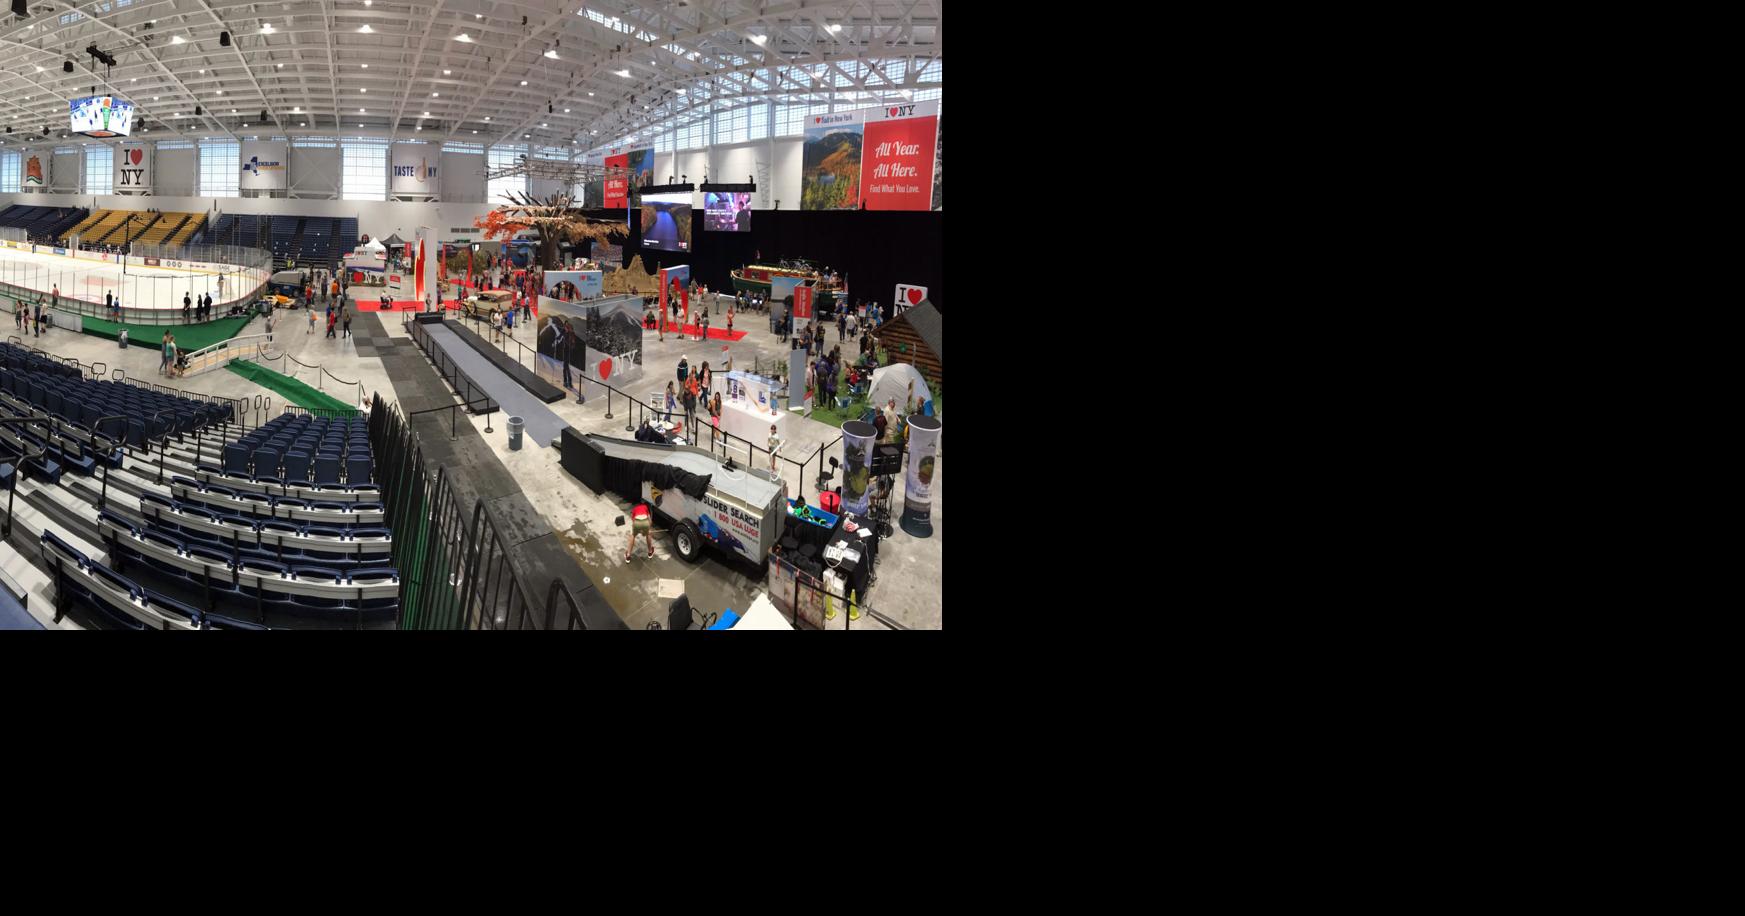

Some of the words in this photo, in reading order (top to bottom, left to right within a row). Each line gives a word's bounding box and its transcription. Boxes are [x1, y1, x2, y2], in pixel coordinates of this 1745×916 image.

[844, 113, 852, 121] York
[885, 107, 890, 118] I
[898, 104, 915, 116] NY
[124, 149, 130, 165] I
[875, 142, 891, 158] All
[893, 141, 919, 156] Year.
[120, 169, 145, 185] NY
[394, 165, 414, 177] TASTE
[428, 167, 438, 177] NY
[874, 163, 890, 179] All
[891, 162, 918, 177] Here.
[869, 184, 881, 193] Find
[881, 184, 895, 193] What
[896, 184, 906, 193] You
[899, 287, 907, 303] I
[613, 349, 638, 377] NY
[703, 495, 728, 515] SLIDER
[730, 507, 759, 528] SEARCH
[731, 519, 743, 530] USA
[744, 525, 759, 537] LUGE
